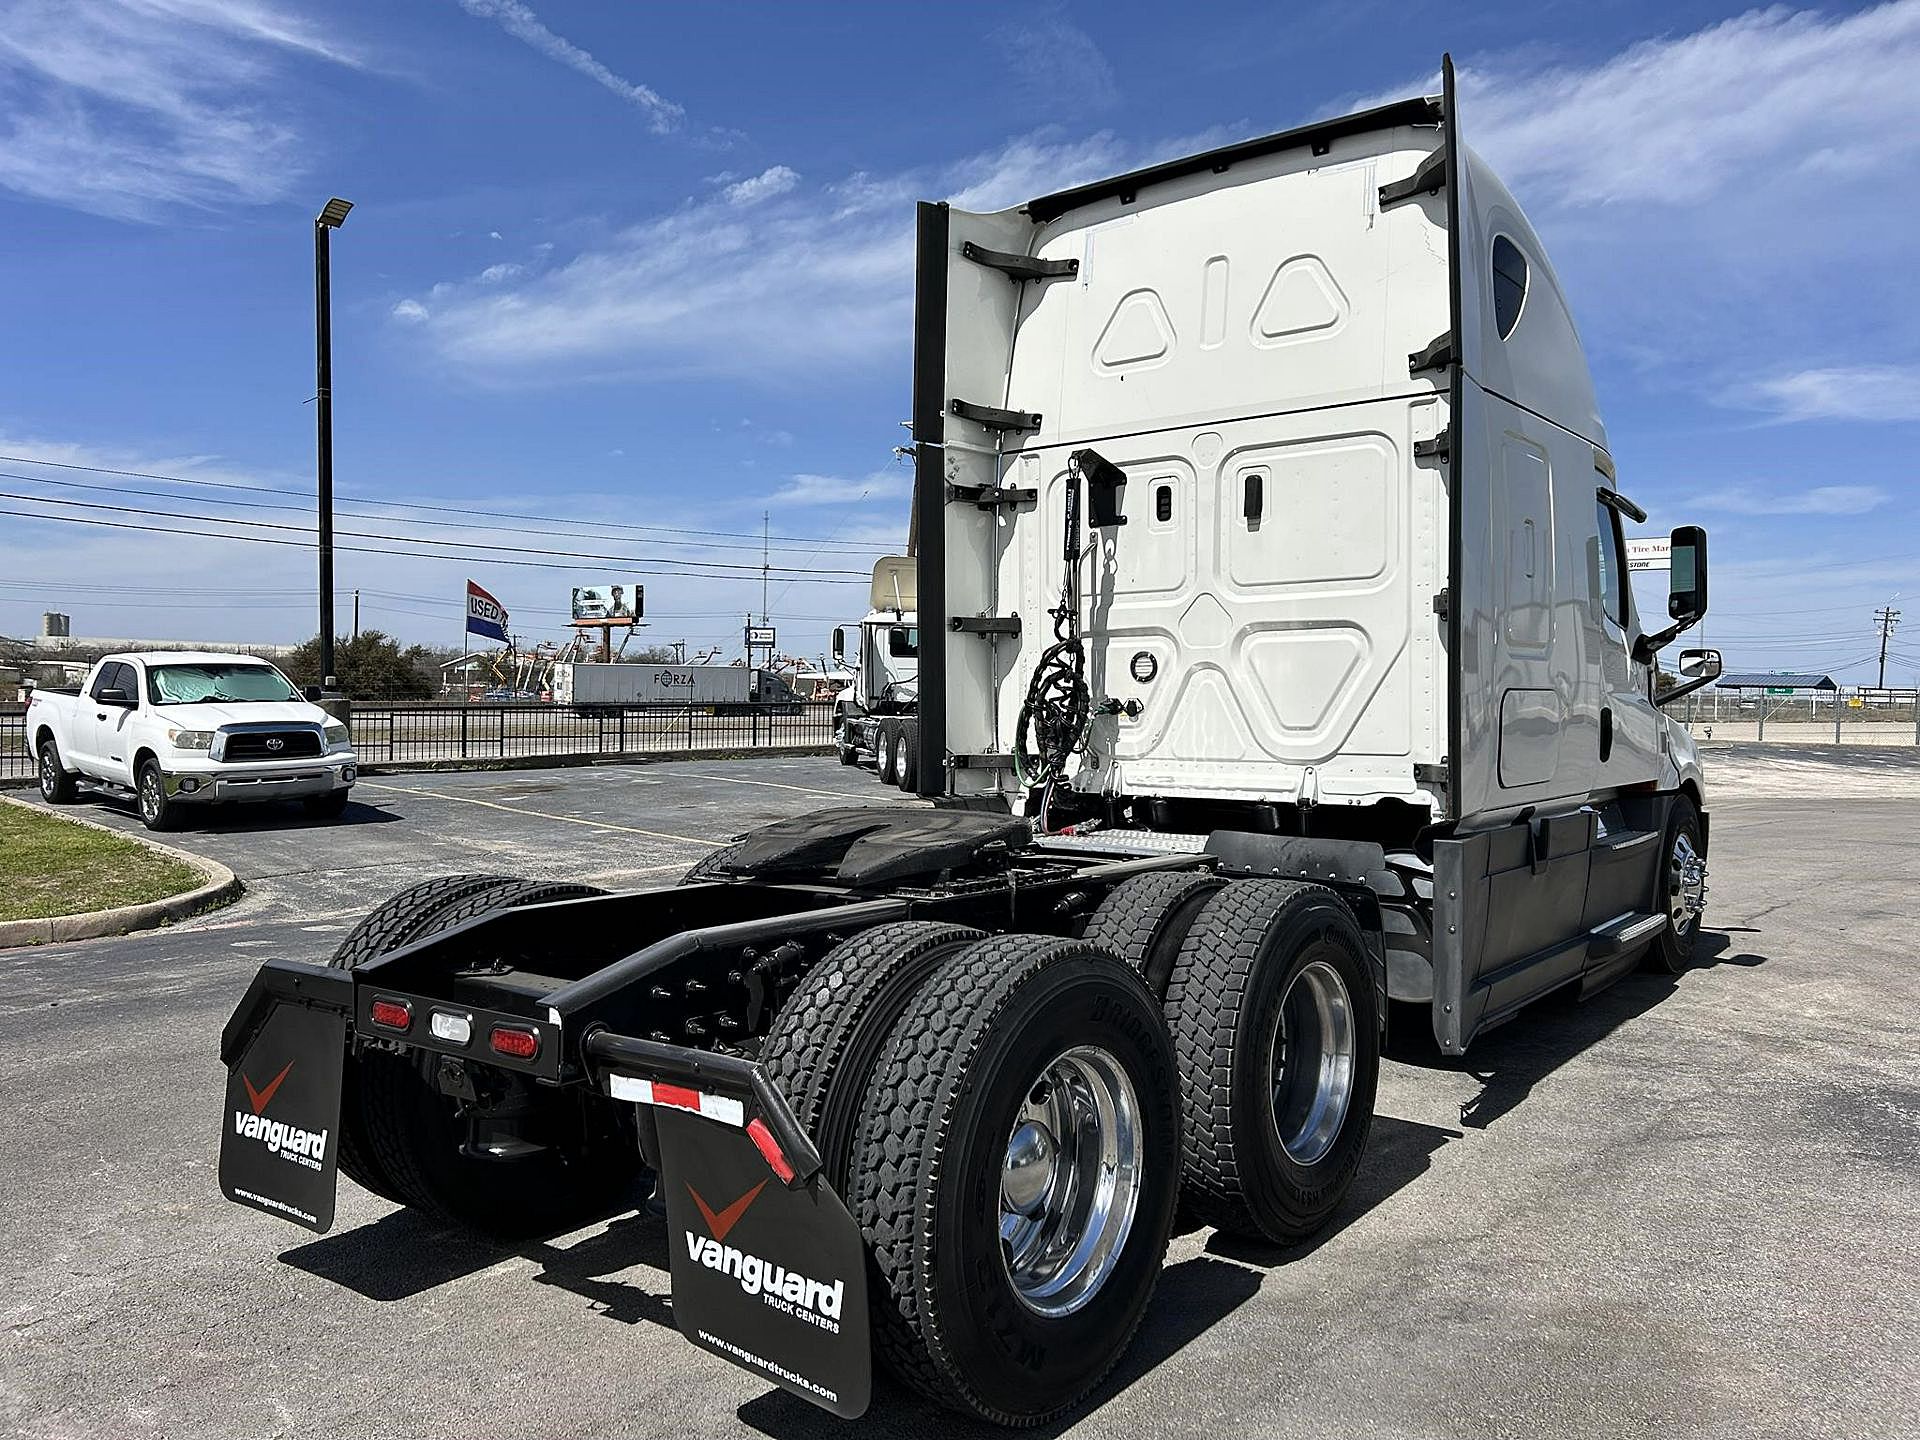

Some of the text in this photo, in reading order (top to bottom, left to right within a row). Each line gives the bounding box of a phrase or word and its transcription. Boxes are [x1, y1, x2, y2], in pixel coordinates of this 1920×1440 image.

[470, 597, 499, 620] USED
[654, 669, 696, 687] FORZA
[235, 1111, 328, 1161] vanguard
[280, 1149, 323, 1172] TRUCK CENTERS
[234, 1187, 318, 1225] www.vanguardtrucks.com
[685, 1230, 845, 1321] vanguard
[763, 1293, 841, 1335] TRUCK CENTERS
[698, 1329, 839, 1404] www.vanguardtrucks.com
